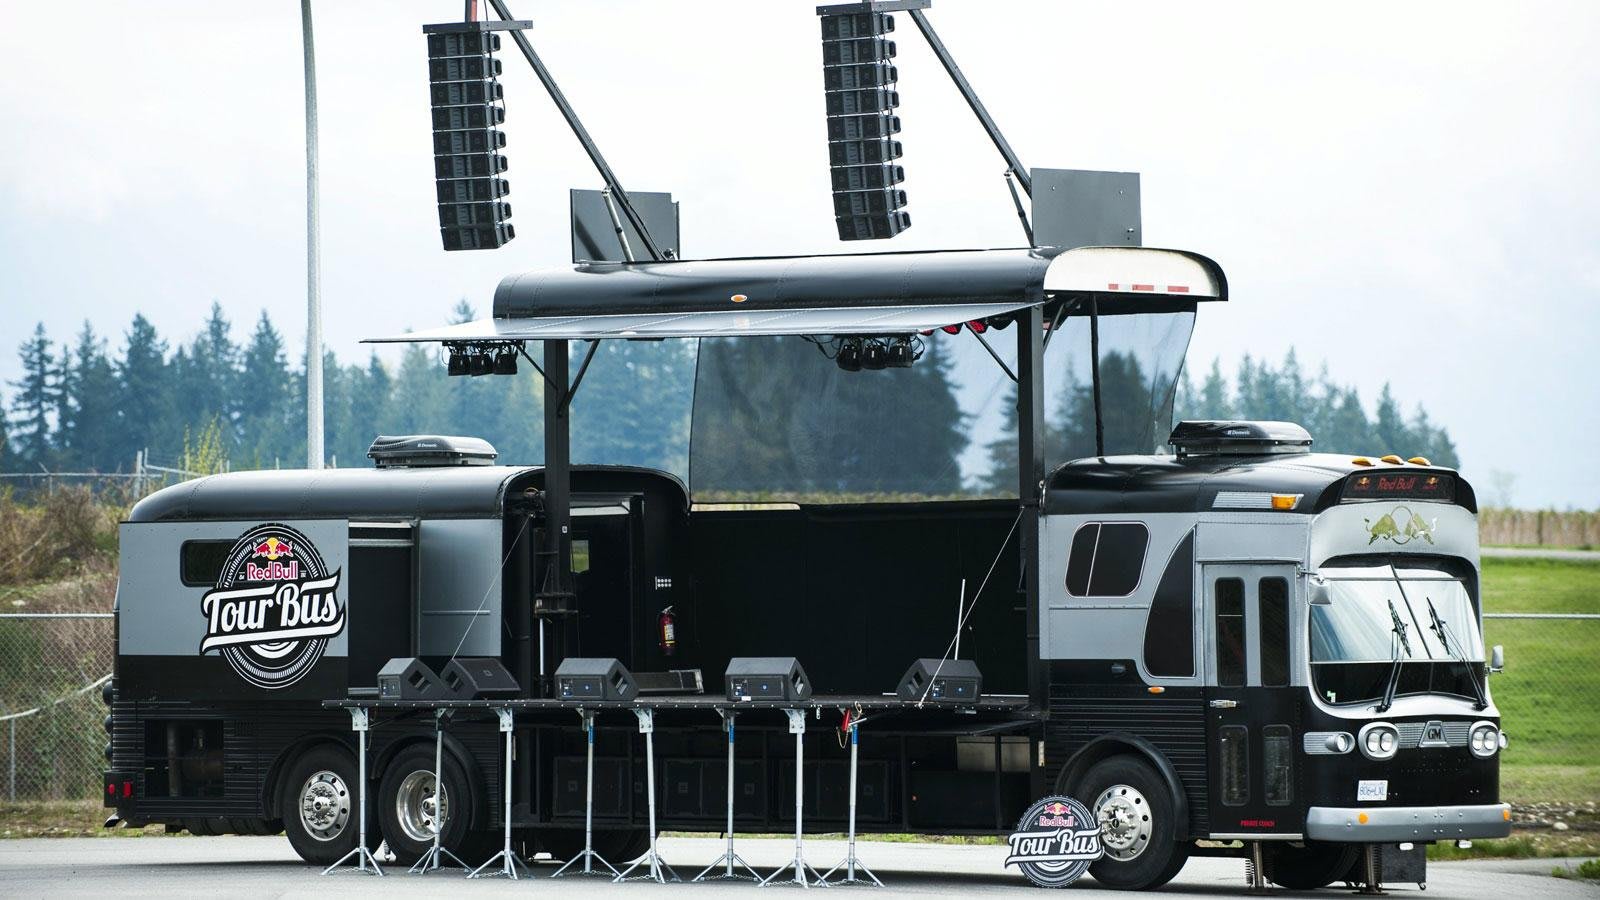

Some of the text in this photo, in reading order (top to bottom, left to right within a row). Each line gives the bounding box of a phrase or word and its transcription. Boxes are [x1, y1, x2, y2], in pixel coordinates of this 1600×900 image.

[1379, 477, 1416, 490] Red Bull
[247, 560, 298, 581] Red Bull
[203, 575, 337, 634] Tour Bus
[1428, 728, 1441, 739] GM
[1039, 815, 1074, 827] Red Bull
[1009, 826, 1101, 856] Tour Bus
